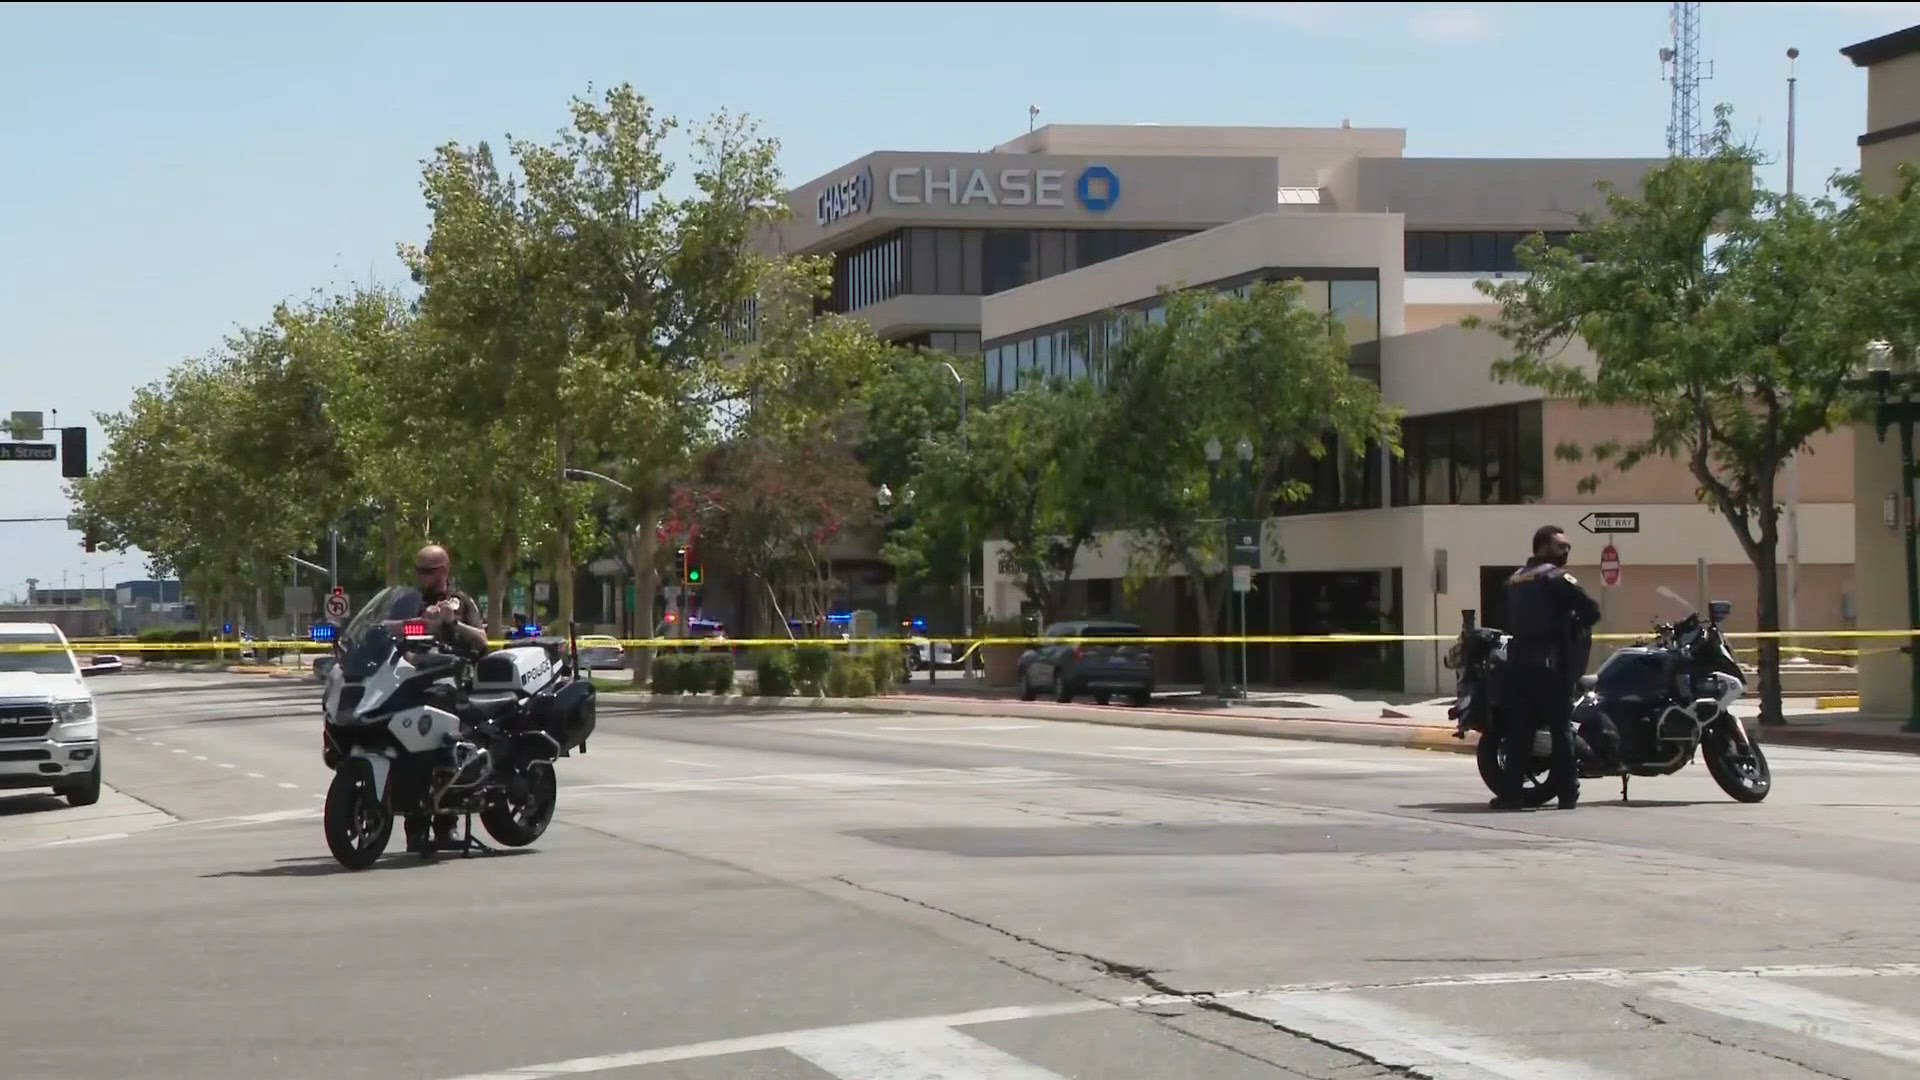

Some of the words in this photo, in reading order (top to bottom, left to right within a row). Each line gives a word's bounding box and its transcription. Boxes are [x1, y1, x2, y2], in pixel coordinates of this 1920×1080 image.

[888, 167, 1065, 207] CHASE
[816, 175, 860, 226] CHASE
[15, 447, 53, 458] Street
[1596, 518, 1612, 527] ONE
[1615, 518, 1632, 527] WAY
[527, 659, 551, 683] POLICE
